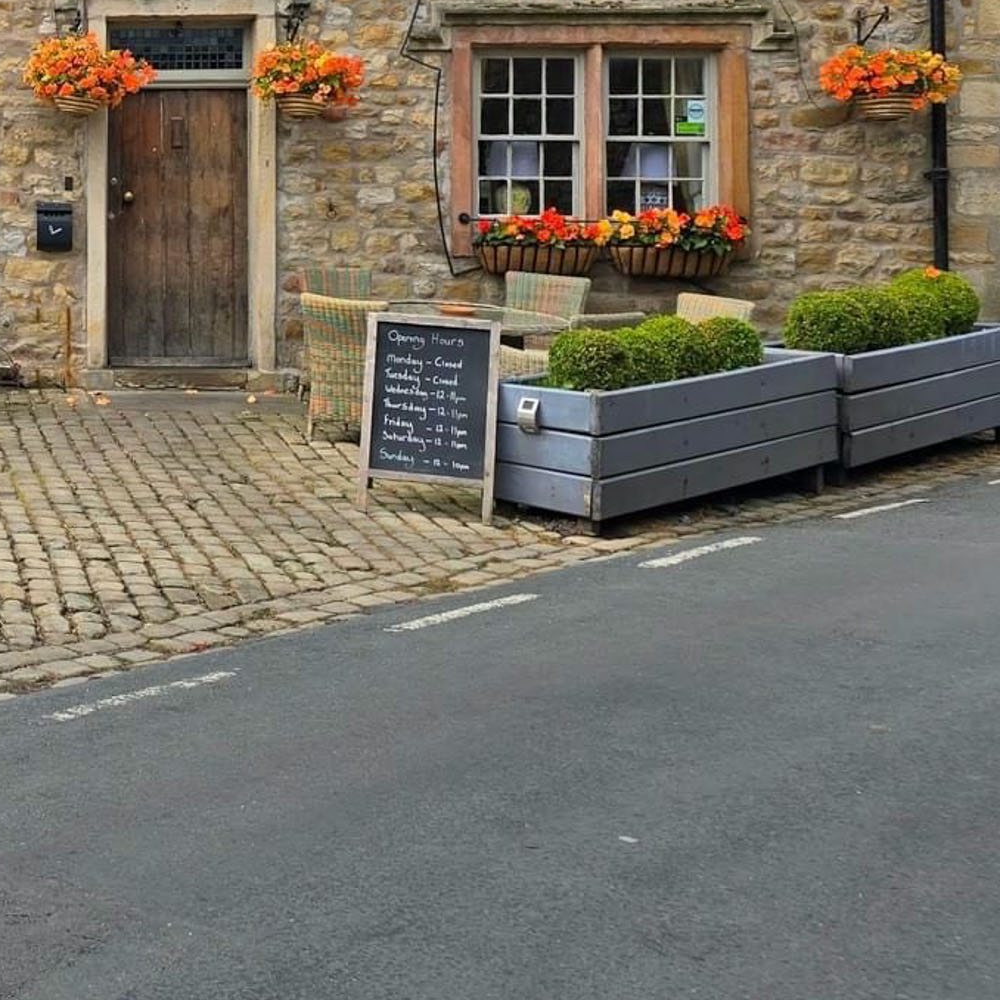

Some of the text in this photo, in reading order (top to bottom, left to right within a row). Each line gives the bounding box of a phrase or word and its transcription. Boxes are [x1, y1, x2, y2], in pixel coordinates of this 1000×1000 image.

[388, 330, 464, 350] Opening Hours
[387, 353, 422, 374] Monday
[435, 356, 463, 369] Closed
[384, 367, 420, 389] Tuesday
[433, 373, 458, 386] Closed
[384, 414, 414, 434] Friday
[382, 430, 427, 452] Saturday
[380, 447, 415, 469] Sunday
